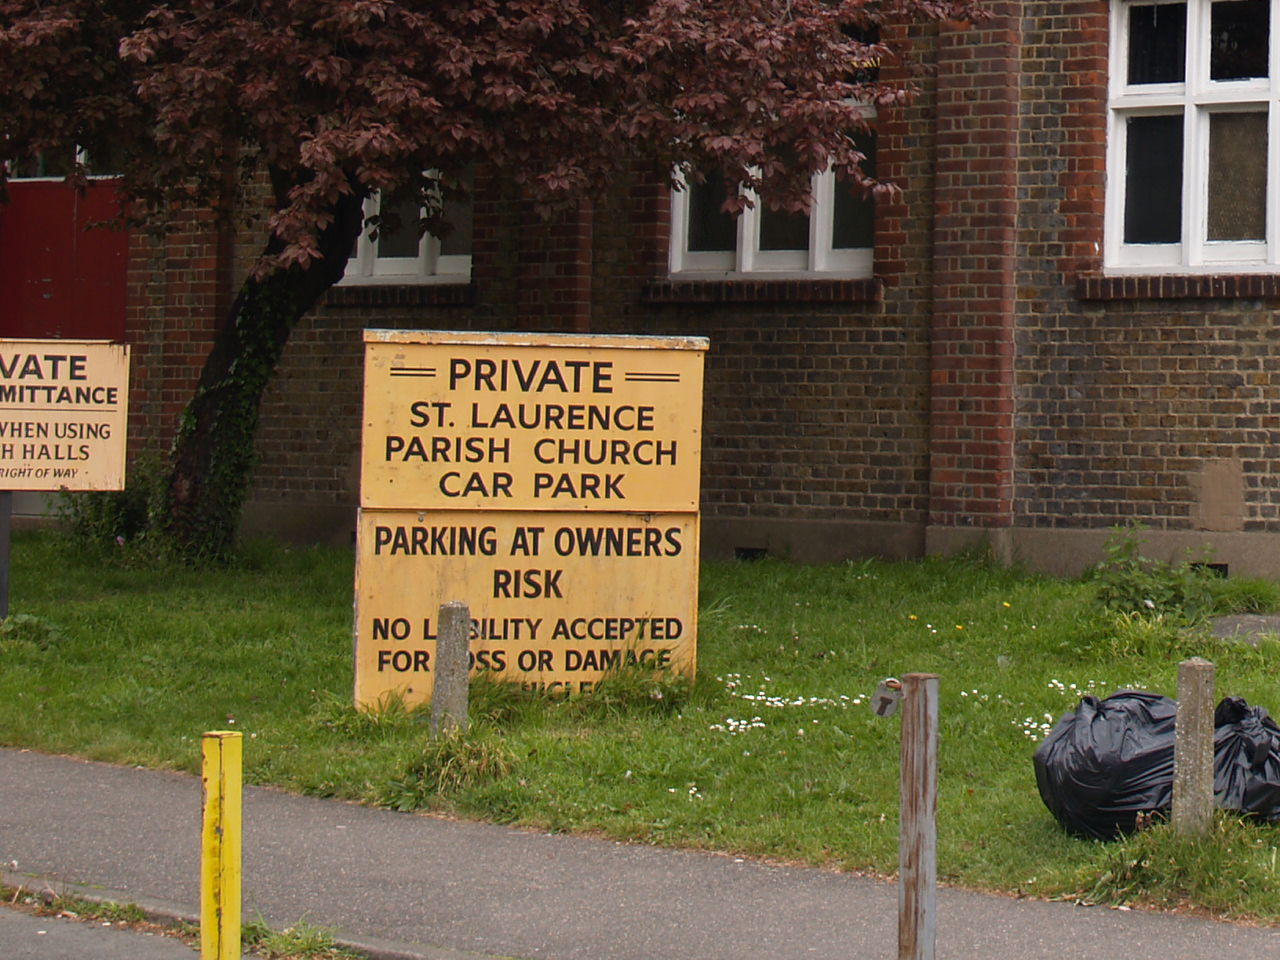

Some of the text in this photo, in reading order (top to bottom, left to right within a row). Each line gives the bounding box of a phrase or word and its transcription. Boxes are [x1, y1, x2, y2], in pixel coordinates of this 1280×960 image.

[0, 354, 88, 381] VATE
[449, 358, 614, 393] PRIVATE
[0, 385, 118, 405] MITTANCE
[410, 402, 655, 431] ST. LAURENCE
[55, 423, 111, 440] USING
[23, 444, 90, 461] HALLS
[385, 436, 678, 465] PARISH CHURCH
[35, 468, 50, 479] OF
[53, 468, 78, 479] WAY
[438, 471, 626, 499] CAR PARK
[374, 526, 683, 558] PARKING AT OWNERS
[493, 569, 563, 599] RISK
[372, 617, 684, 640] NO LBILITY ACCEPTED
[377, 649, 430, 672] FOR
[517, 649, 554, 672] OR
[564, 649, 672, 672] DAMAGE
